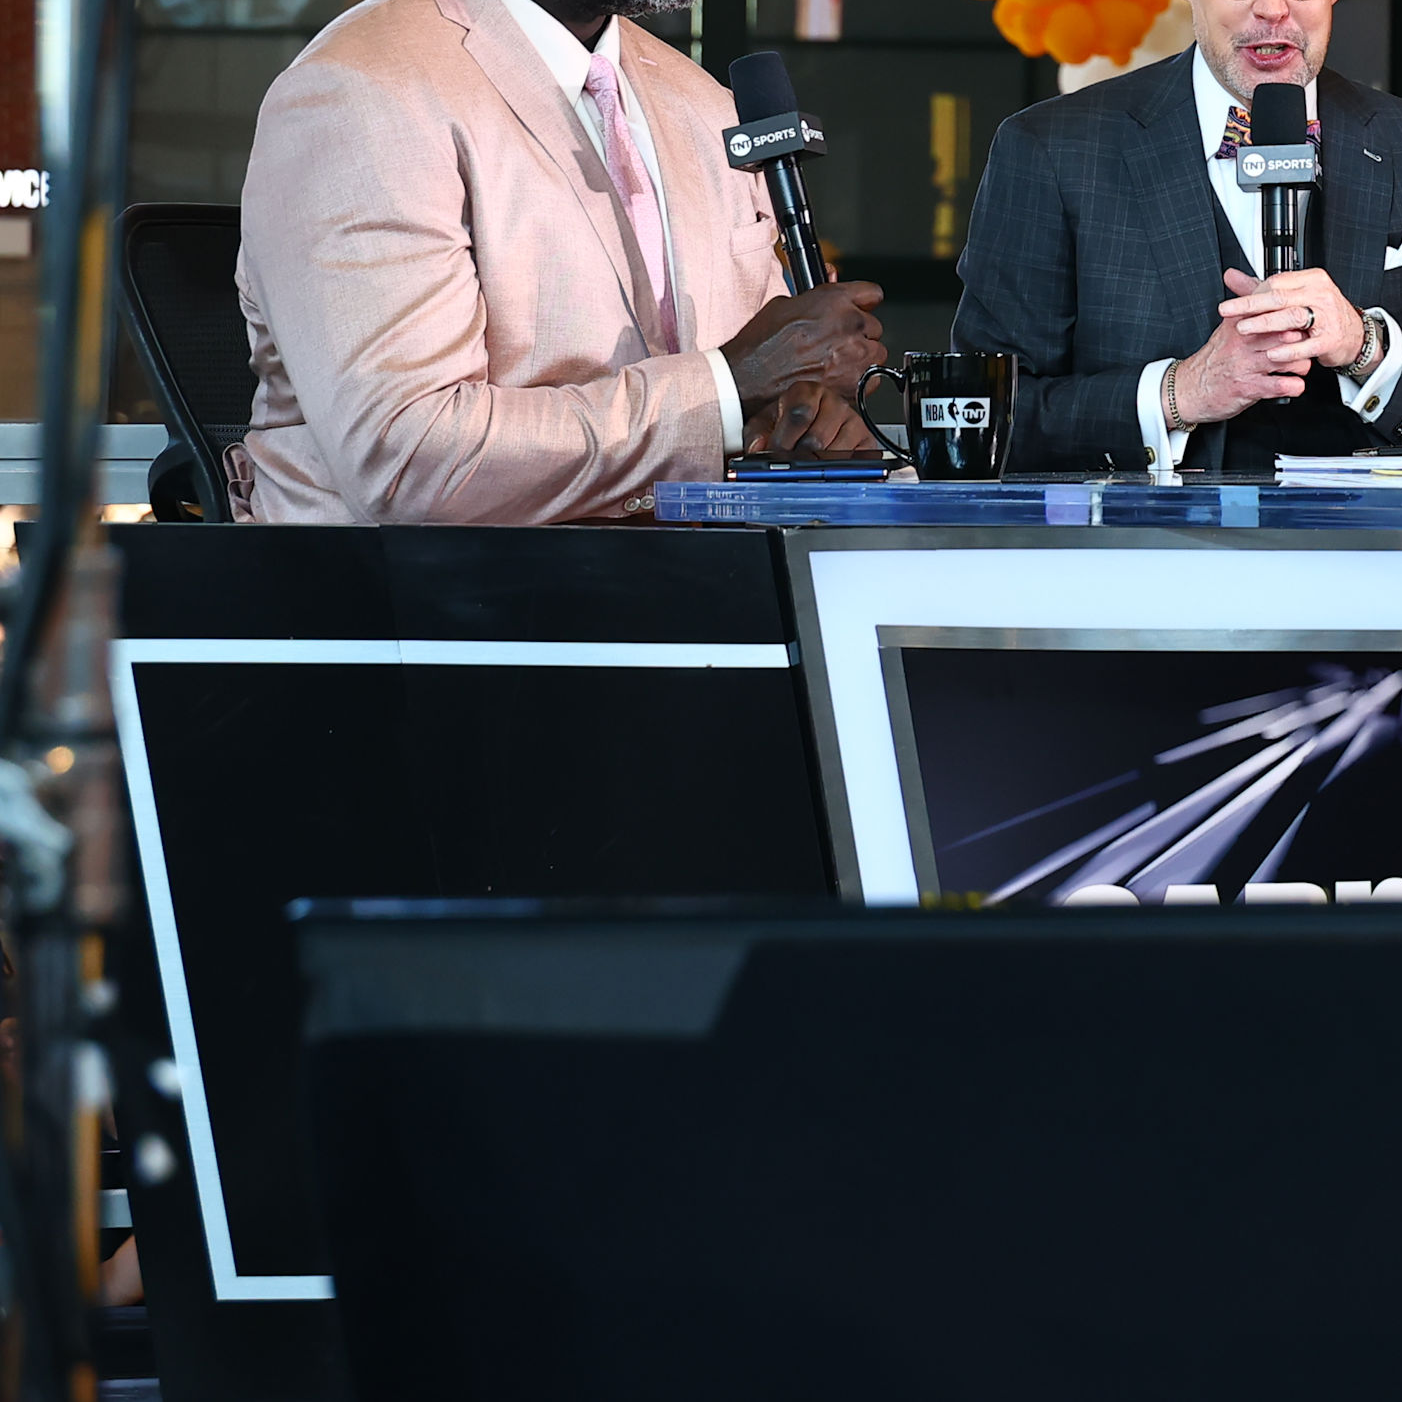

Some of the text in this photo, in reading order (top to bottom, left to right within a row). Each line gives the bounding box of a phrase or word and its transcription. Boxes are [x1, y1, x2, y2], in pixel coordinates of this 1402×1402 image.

[753, 127, 796, 147] SPORTS
[1267, 158, 1314, 171] SPORTS
[925, 403, 945, 422] NBA
